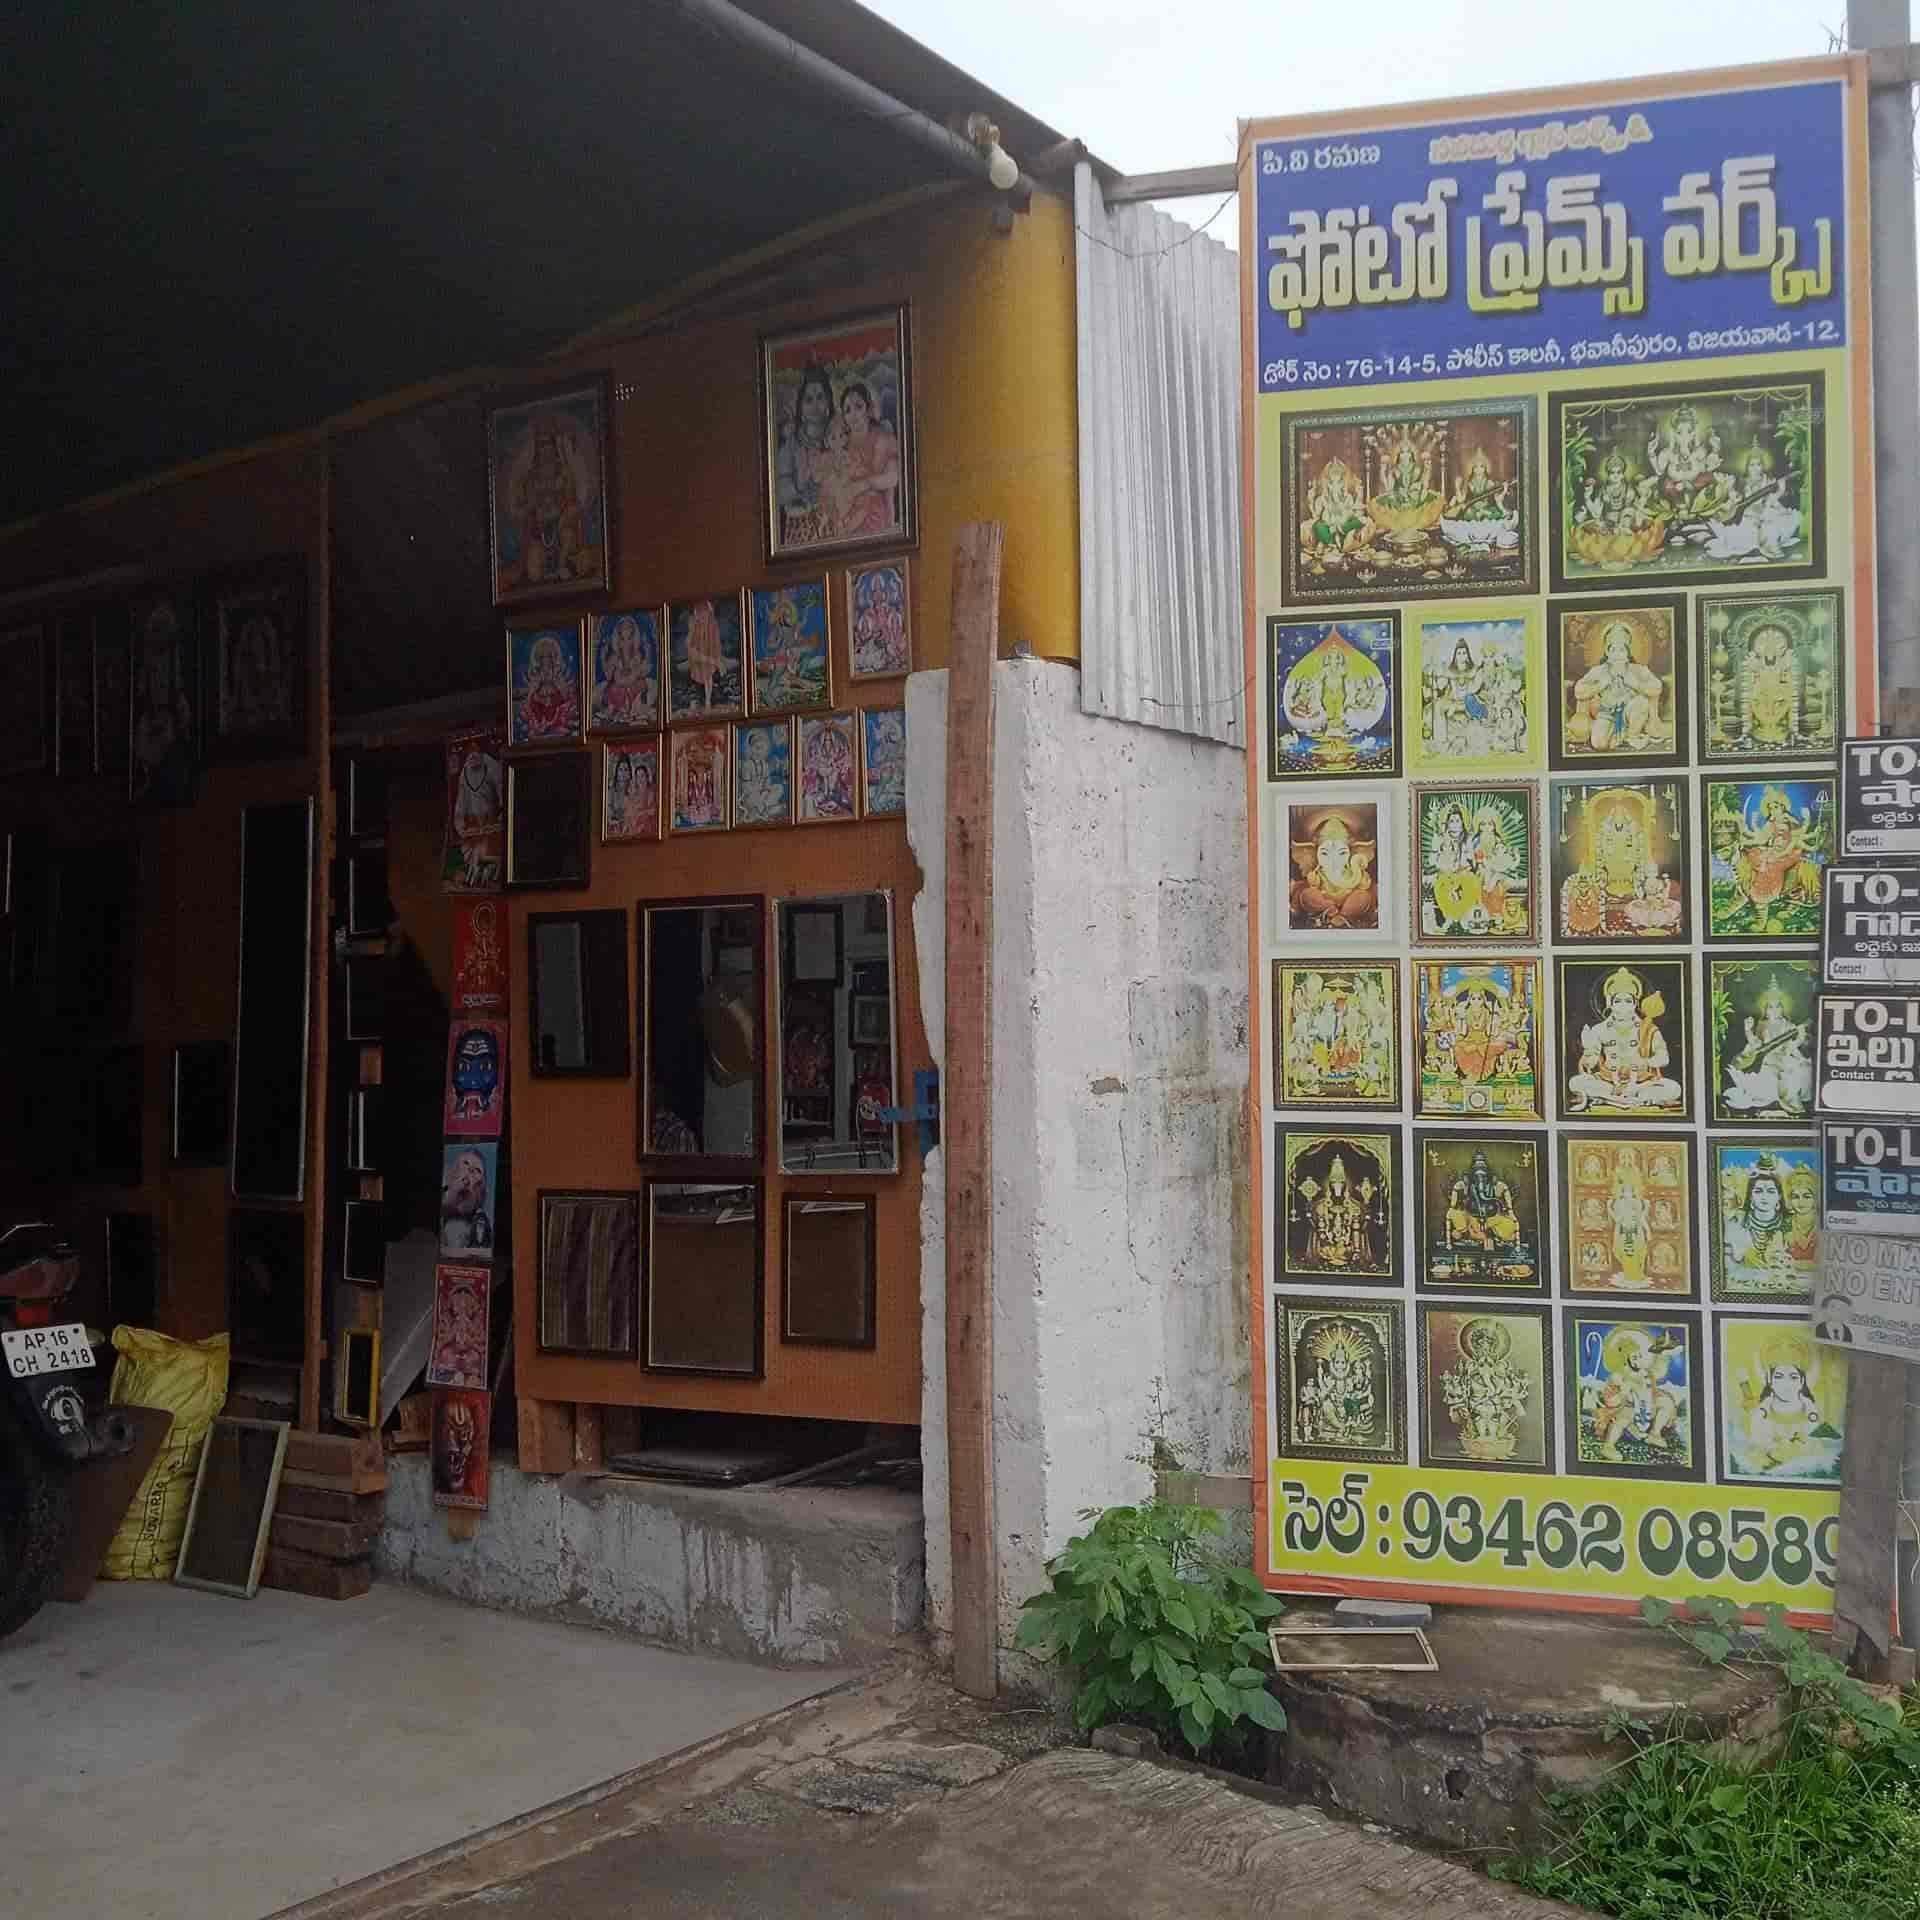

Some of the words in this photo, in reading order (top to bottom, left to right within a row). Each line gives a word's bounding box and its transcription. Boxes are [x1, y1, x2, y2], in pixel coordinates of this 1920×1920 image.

[1830, 1069, 1875, 1081] Contact
[47, 1348, 90, 1368] 2418
[1402, 1490, 1626, 1573] 93462
